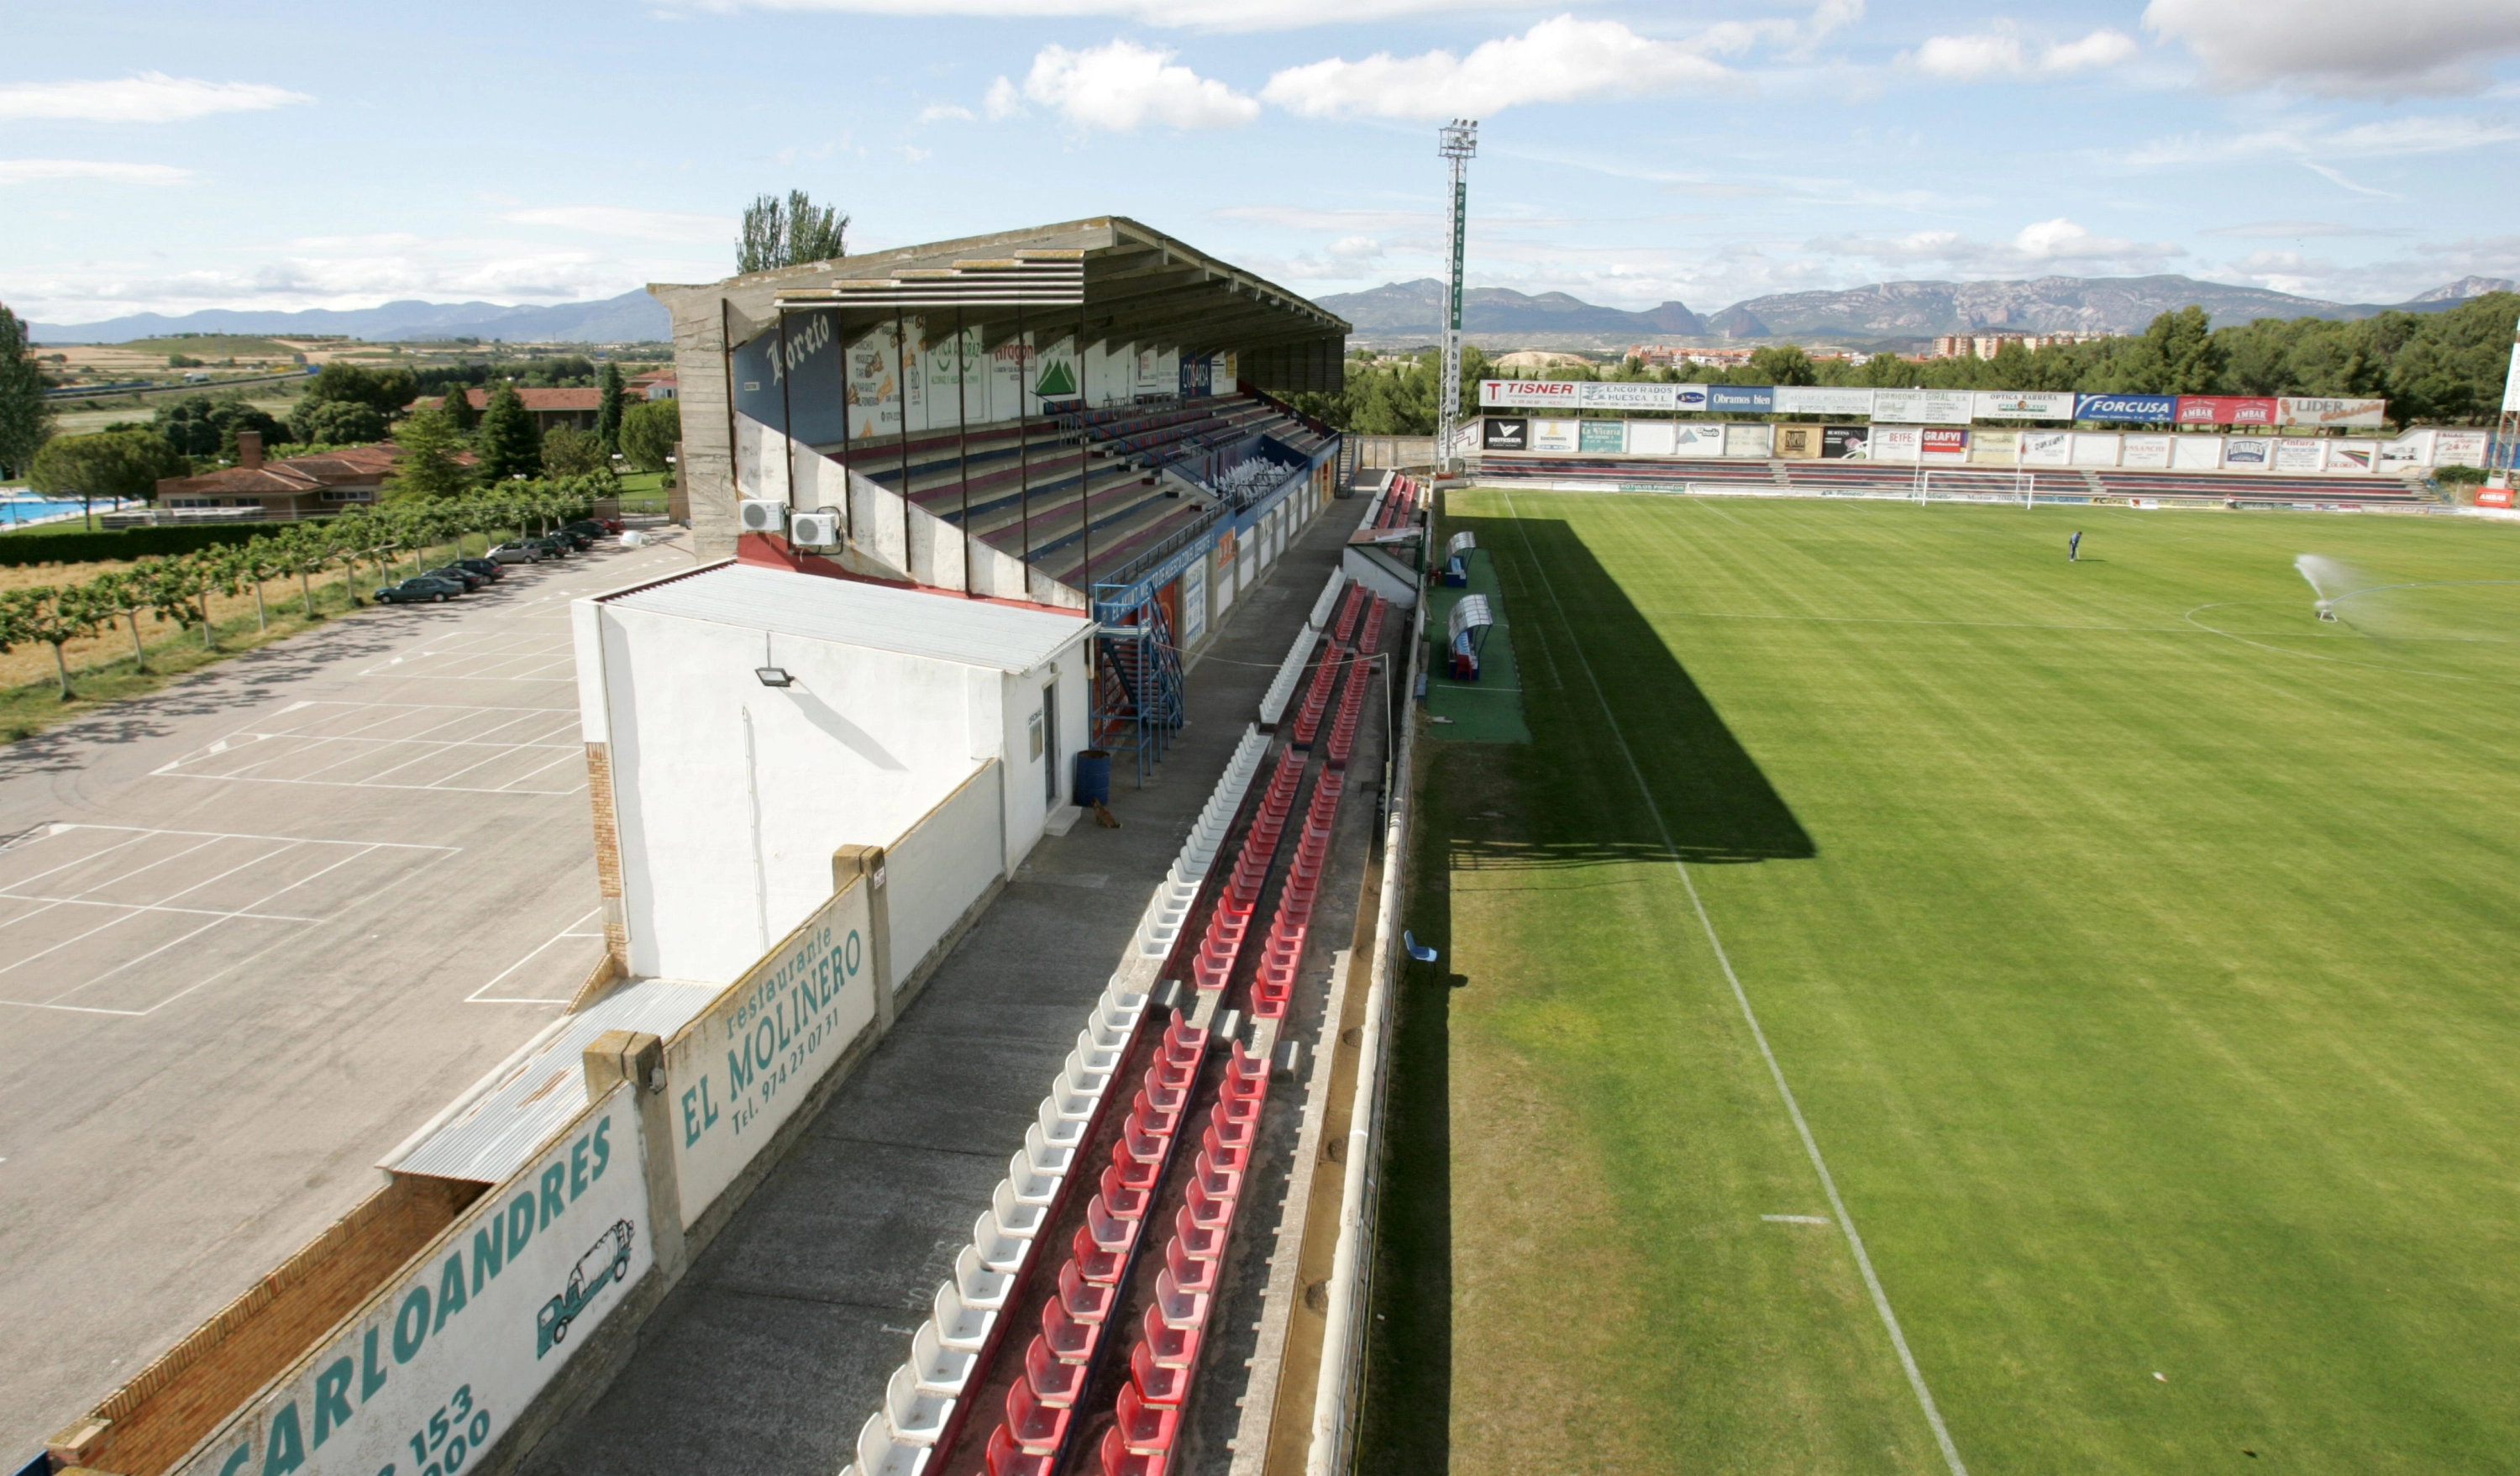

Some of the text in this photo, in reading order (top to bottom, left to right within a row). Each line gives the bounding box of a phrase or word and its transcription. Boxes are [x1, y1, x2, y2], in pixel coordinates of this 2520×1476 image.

[1453, 196, 1463, 320] Fertiberia
[766, 313, 829, 386] Loreto
[953, 341, 980, 357] AORAZ
[1508, 383, 1574, 394] TISNER
[1607, 386, 1672, 394] ENCOFRADOS
[1713, 393, 1750, 404] Obramos
[1754, 395, 1771, 405] bien
[1875, 392, 1922, 401] HORMIGONES
[1925, 391, 1950, 401] GIRAL
[2092, 401, 2170, 413] FORCUSA
[2297, 400, 2344, 412] LIDER
[2181, 408, 2213, 418] AMBAR
[2234, 409, 2266, 420] AMBAR
[1924, 431, 1961, 442] GRAFVI
[2479, 493, 2507, 502] AMBAR
[726, 926, 831, 1040] restaurante
[682, 929, 861, 1150] EL MOLINERO
[762, 1063, 786, 1105] 974
[790, 1043, 805, 1074] 23
[808, 1023, 822, 1054] 07
[825, 1006, 838, 1036] 31
[410, 1384, 474, 1467] 153
